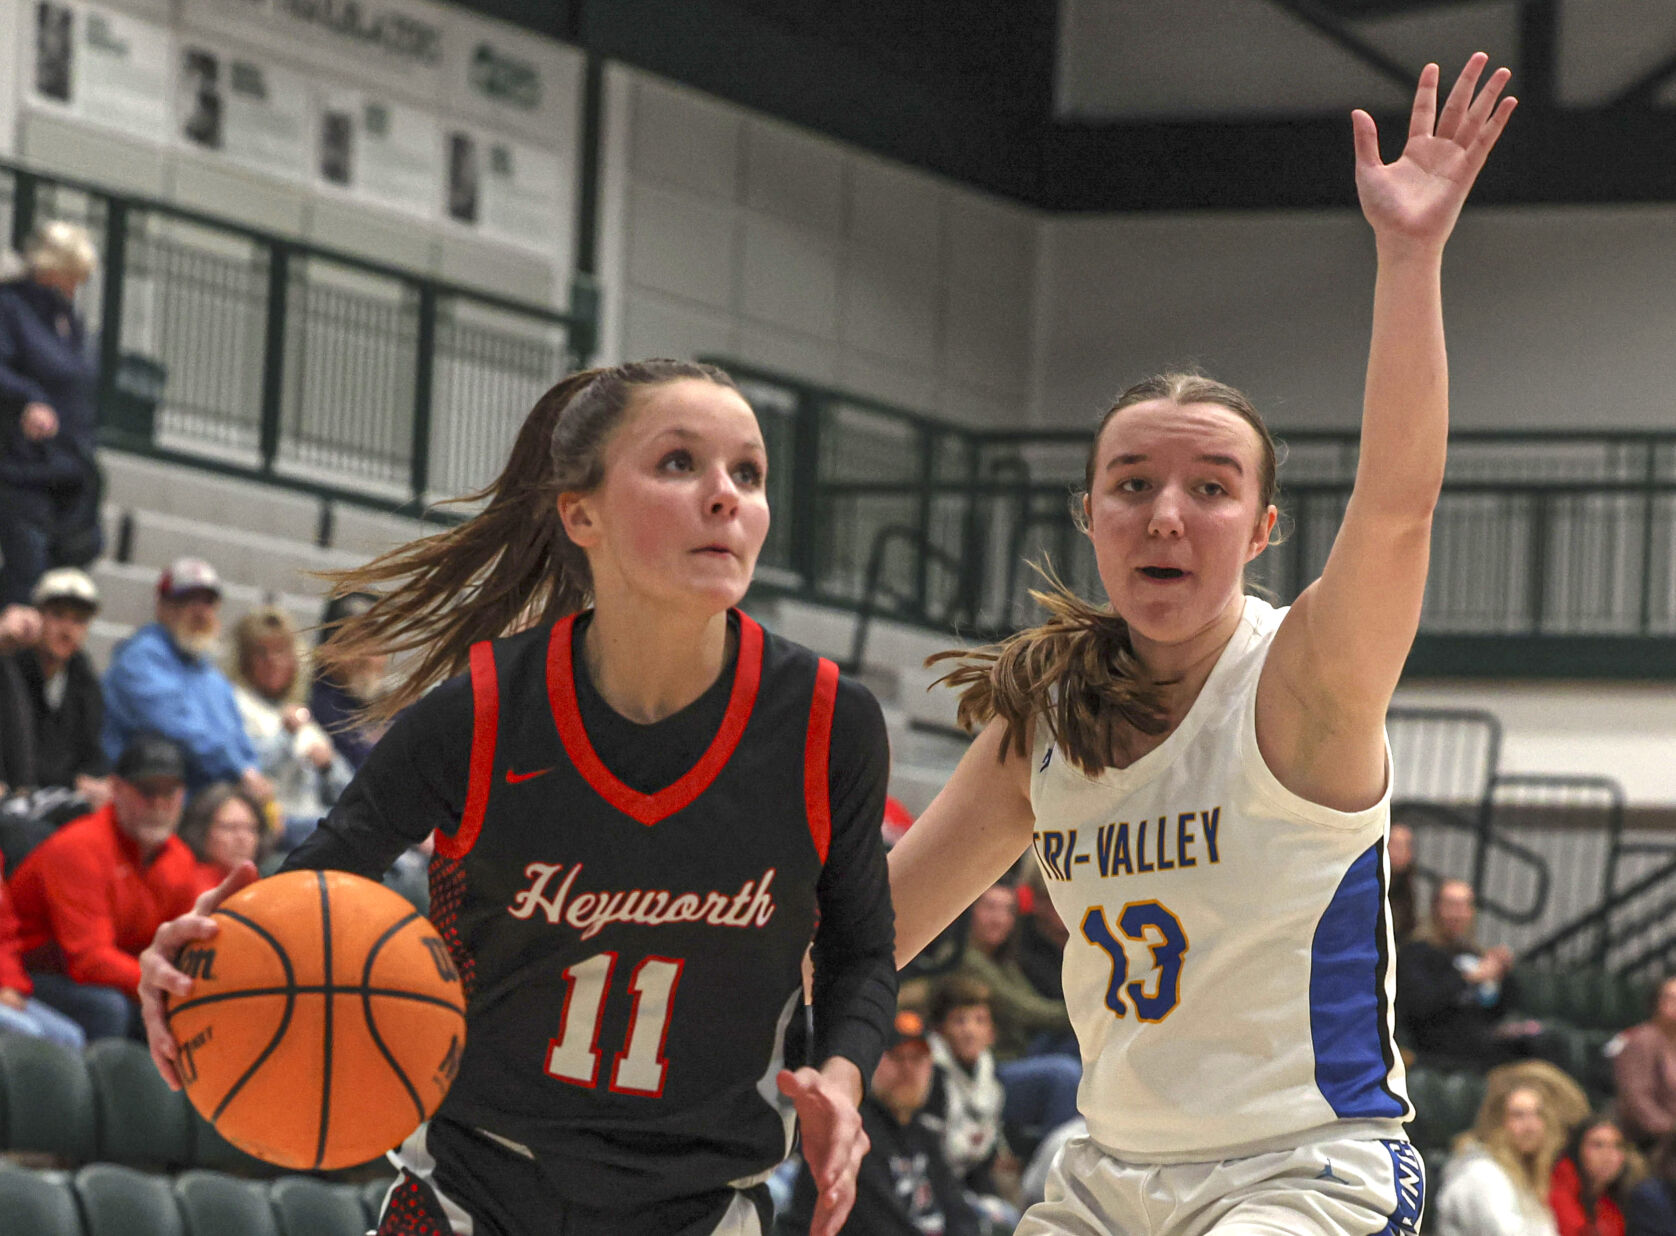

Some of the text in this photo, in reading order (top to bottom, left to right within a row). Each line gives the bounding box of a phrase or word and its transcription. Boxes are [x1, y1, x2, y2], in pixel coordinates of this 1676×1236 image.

[507, 861, 776, 941] Heyworth
[1079, 899, 1190, 1024] 13
[543, 951, 685, 1099] 11
